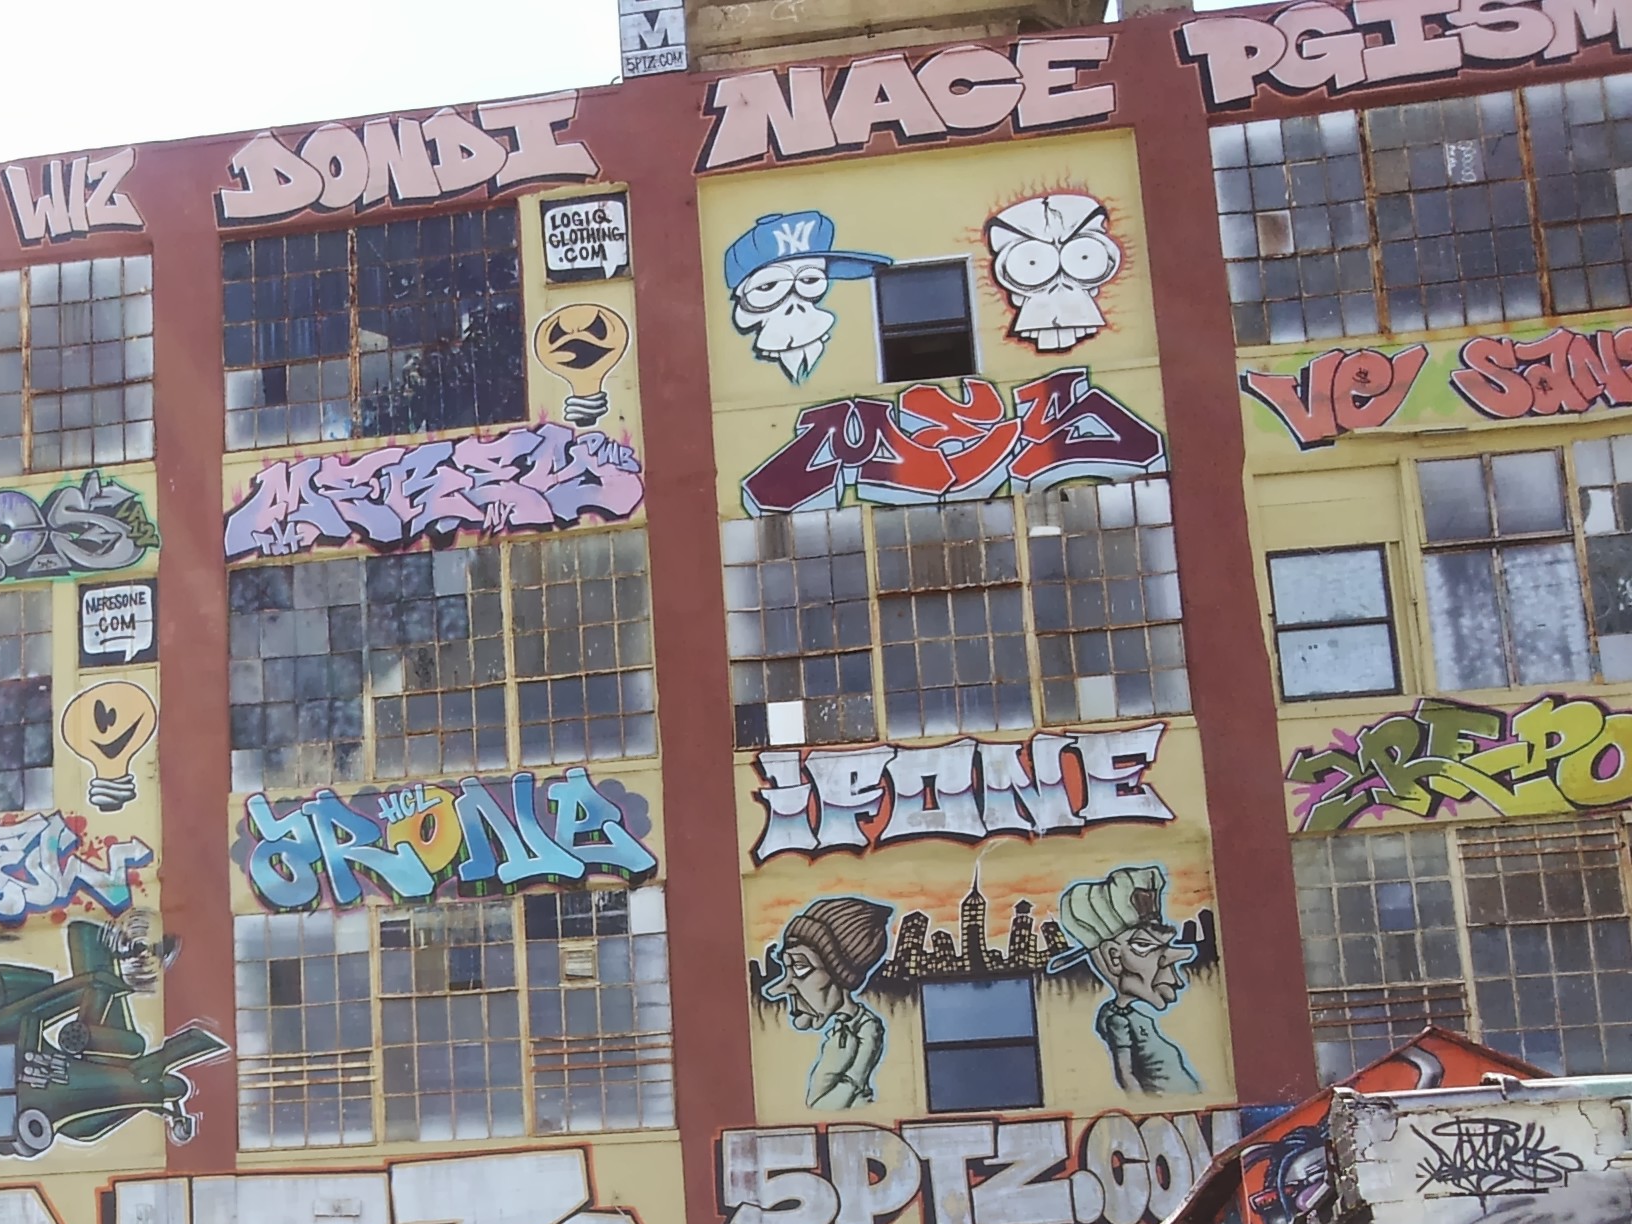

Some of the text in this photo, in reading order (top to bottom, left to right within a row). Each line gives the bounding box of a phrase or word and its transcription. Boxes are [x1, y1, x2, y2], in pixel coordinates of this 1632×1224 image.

[625, 52, 685, 74] 5PTZ.COM
[696, 36, 1117, 171] NACE
[1, 147, 146, 246] WIZ
[219, 91, 600, 221] DONDI
[84, 590, 147, 615] MERESONE
